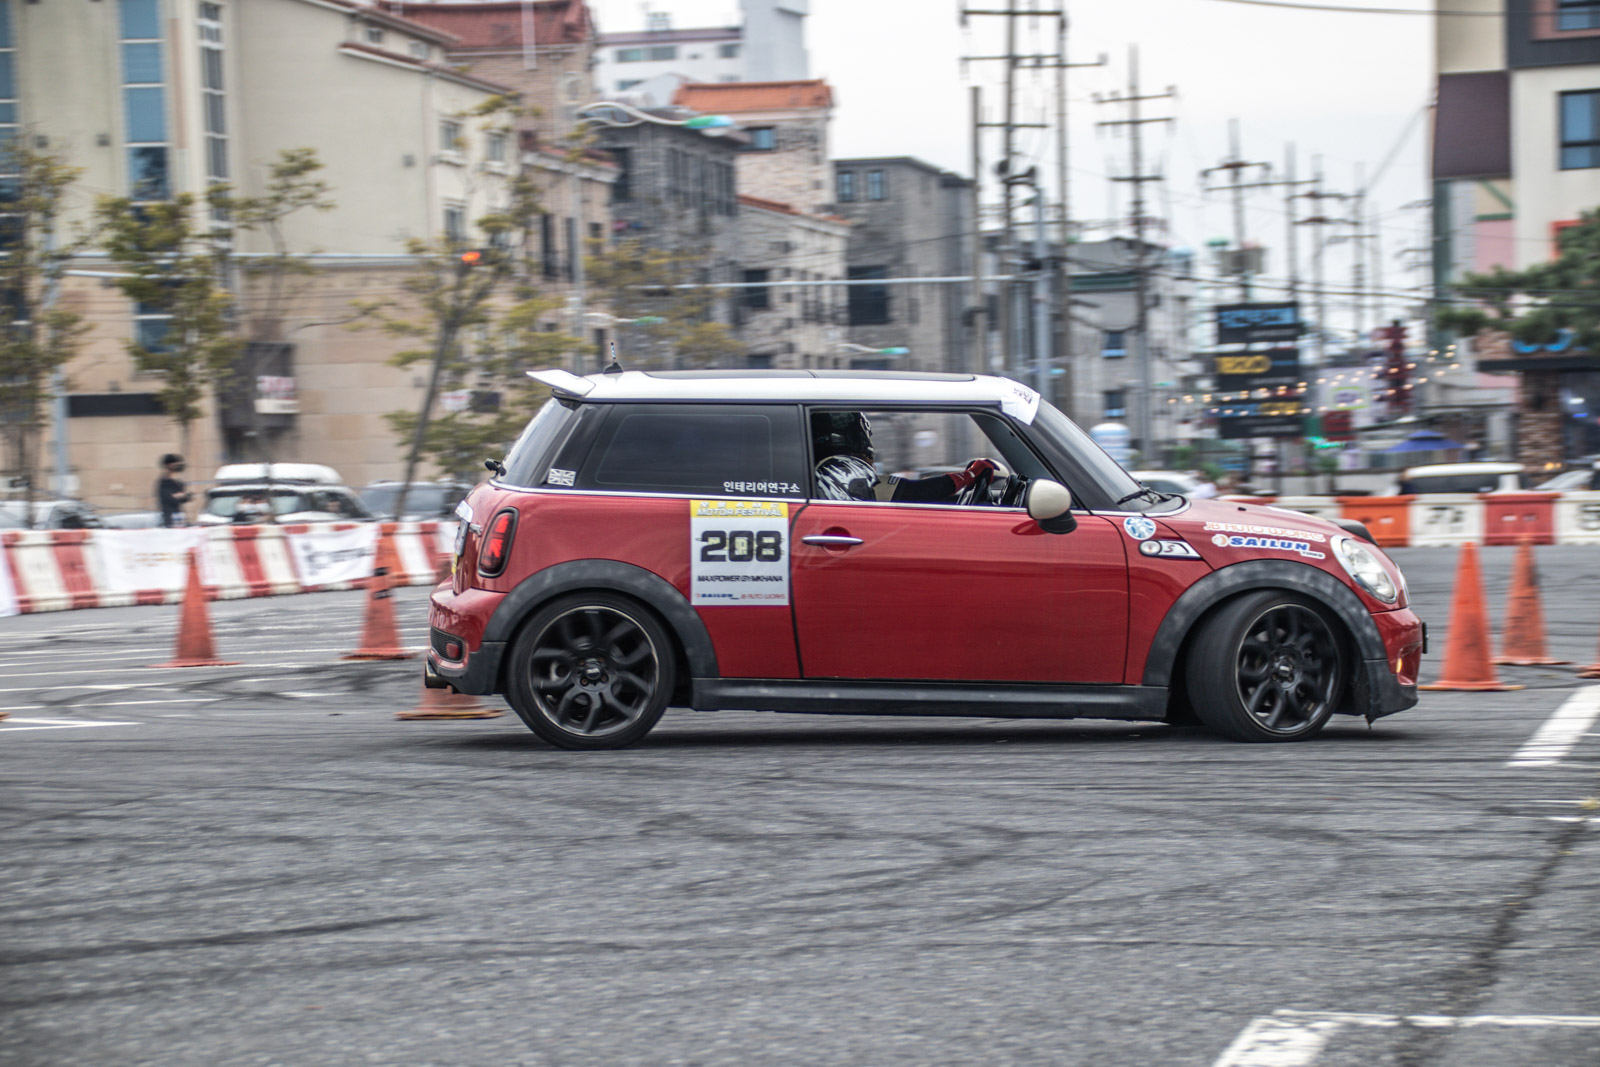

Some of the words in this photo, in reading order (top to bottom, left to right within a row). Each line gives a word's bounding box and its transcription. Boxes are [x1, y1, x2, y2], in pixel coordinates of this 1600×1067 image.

[723, 481, 800, 493] 인테리어연구소
[700, 530, 782, 562] 208
[1230, 537, 1308, 551] SAILUN
